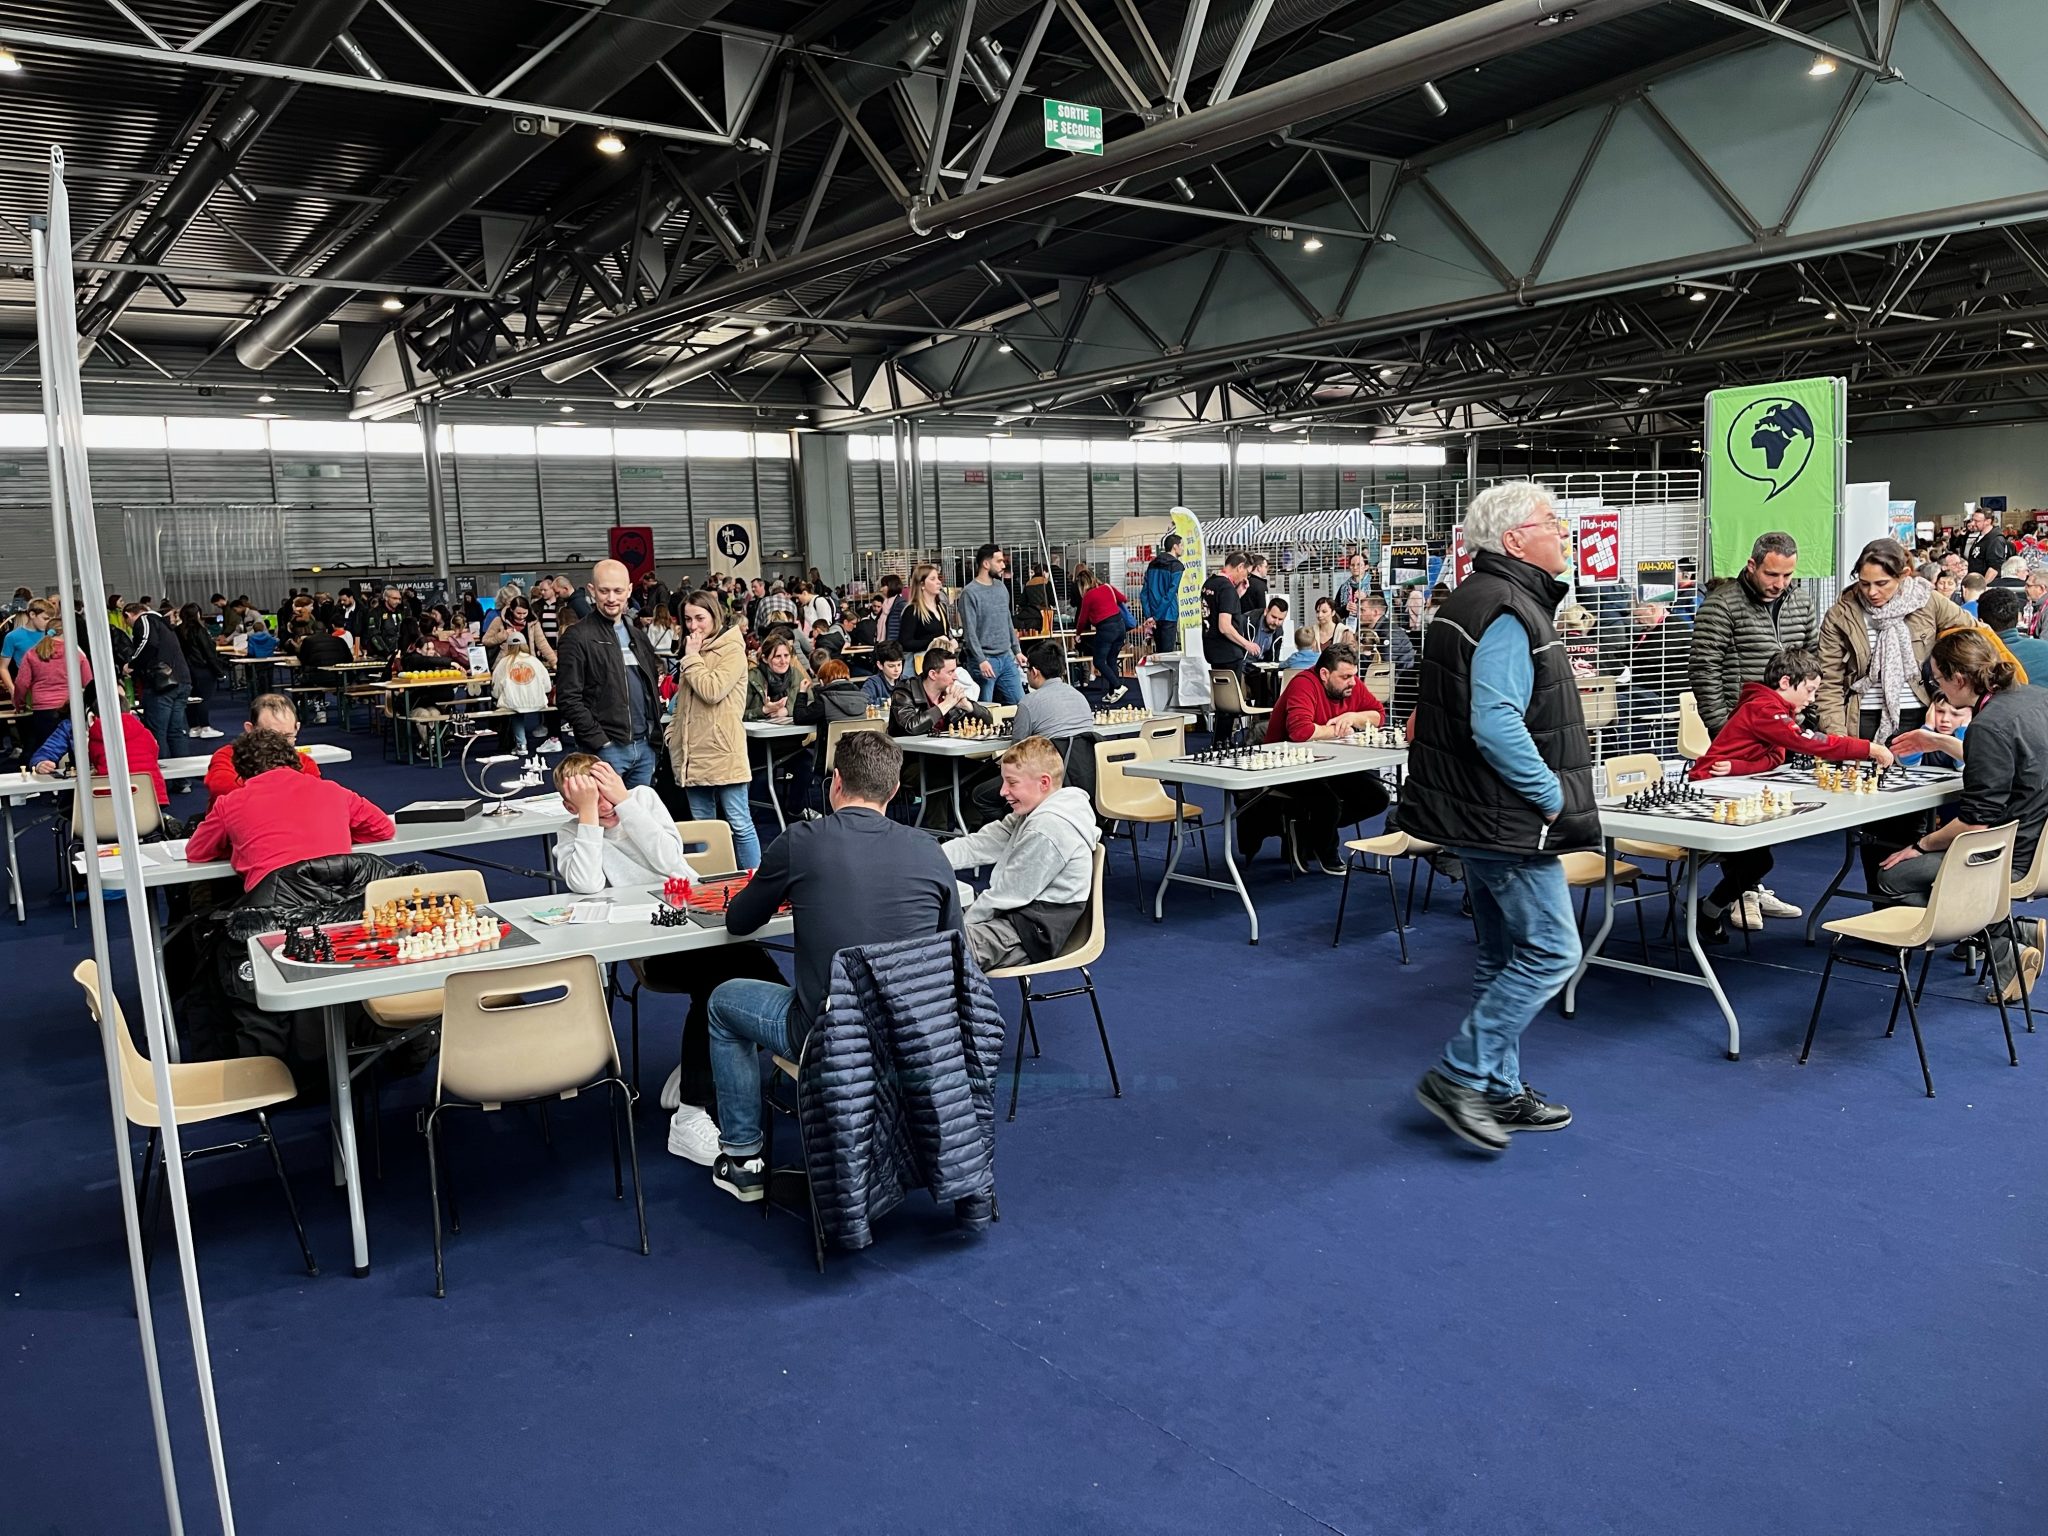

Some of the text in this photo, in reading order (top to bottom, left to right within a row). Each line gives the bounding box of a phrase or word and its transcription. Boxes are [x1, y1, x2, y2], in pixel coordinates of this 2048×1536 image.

[1058, 104, 1089, 122] SORTIE
[1046, 118, 1101, 139] DE SECOURS
[1391, 547, 1426, 556] MAH-JONG
[1638, 561, 1675, 571] MAH-JONG
[396, 581, 434, 590] WAKALASE
